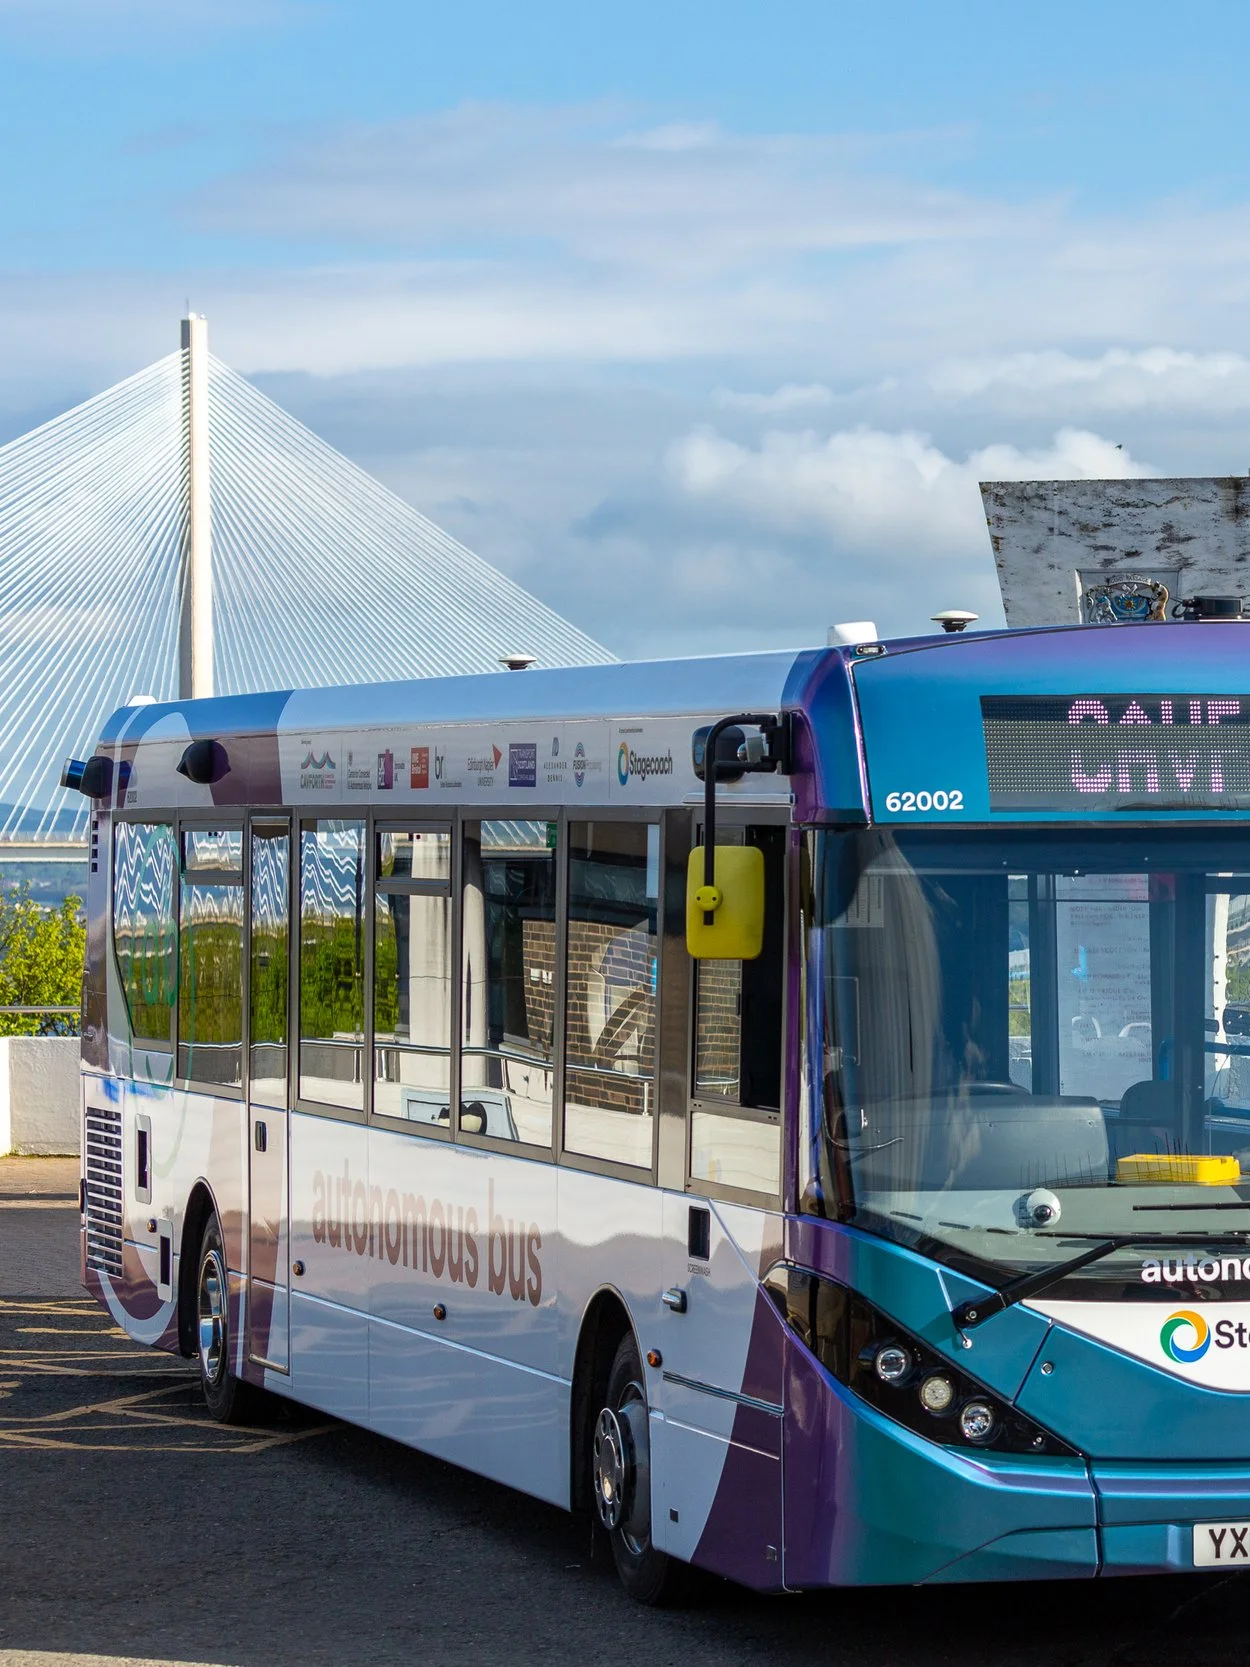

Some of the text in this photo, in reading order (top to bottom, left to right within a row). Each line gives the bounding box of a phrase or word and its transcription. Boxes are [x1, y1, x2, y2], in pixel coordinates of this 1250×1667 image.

[630, 748, 673, 781] Stagecoach
[886, 789, 964, 813] 62002
[311, 1158, 542, 1307] autonomous bus
